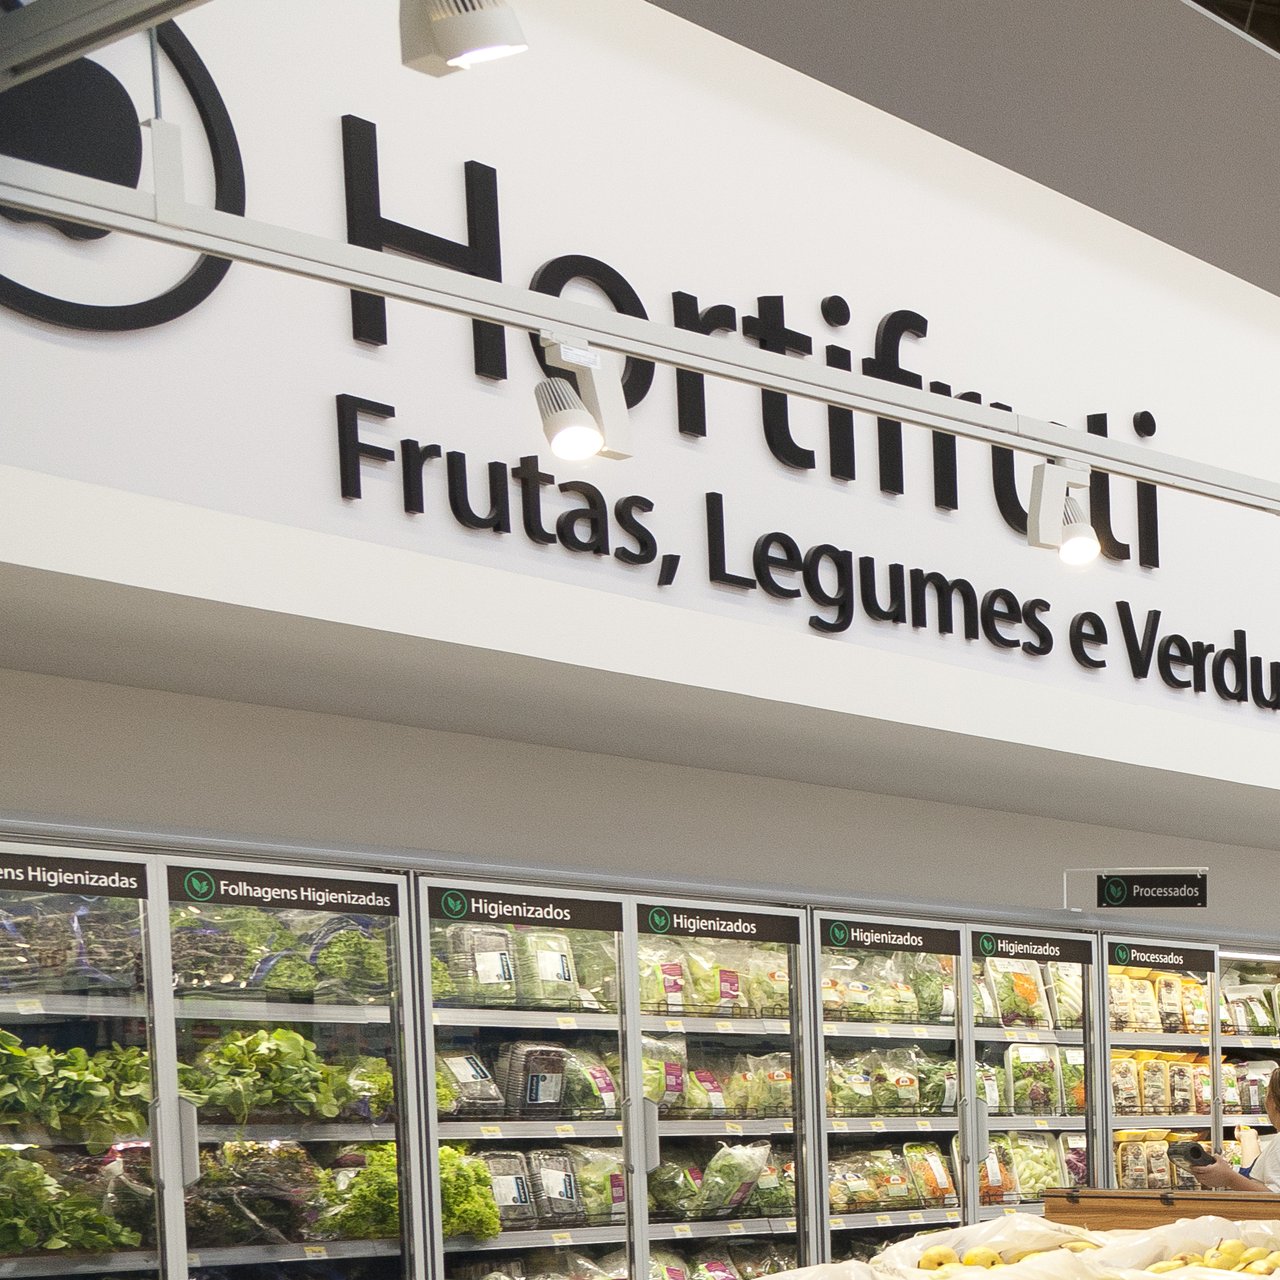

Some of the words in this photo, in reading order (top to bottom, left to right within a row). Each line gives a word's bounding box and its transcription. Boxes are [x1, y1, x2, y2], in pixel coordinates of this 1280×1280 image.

[336, 393, 681, 588] Frutas,
[704, 491, 1056, 635] Legumes
[1069, 610, 1109, 670] e
[27, 866, 138, 890] Higienizadas
[219, 880, 298, 902] Folhagens
[300, 887, 391, 908] Higienizadas
[1132, 884, 1200, 899] Processados
[471, 898, 571, 922] Higienizados
[673, 914, 757, 934] Higienizados
[850, 927, 924, 948] Higienizados
[997, 939, 1061, 957] Higienizados
[1130, 949, 1184, 966] Processados
